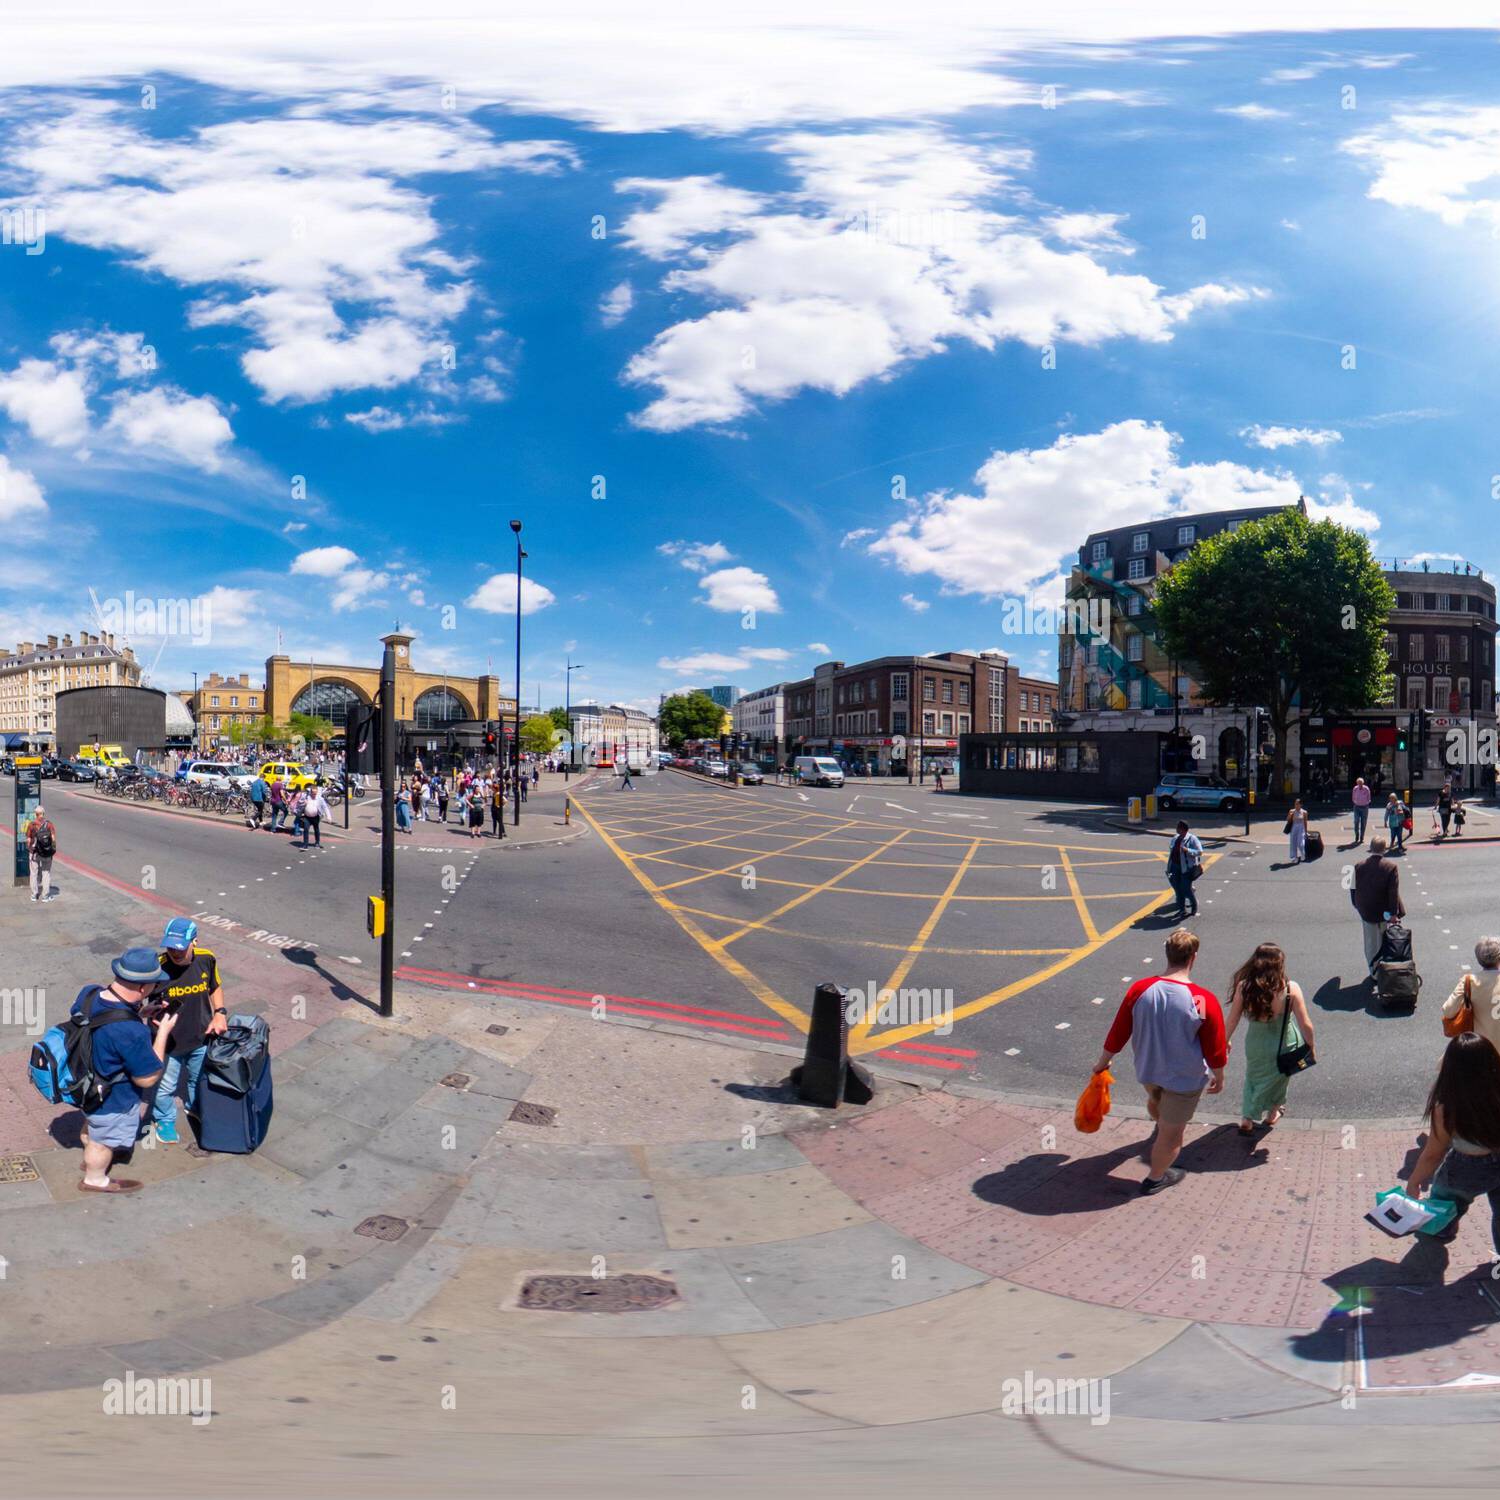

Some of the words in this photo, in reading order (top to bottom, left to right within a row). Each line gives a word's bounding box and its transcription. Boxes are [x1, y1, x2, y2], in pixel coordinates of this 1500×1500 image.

[1402, 663, 1453, 675] HOUSE
[190, 911, 242, 931] LOOK
[245, 929, 320, 949] RIGHT
[168, 981, 208, 997] #boost
